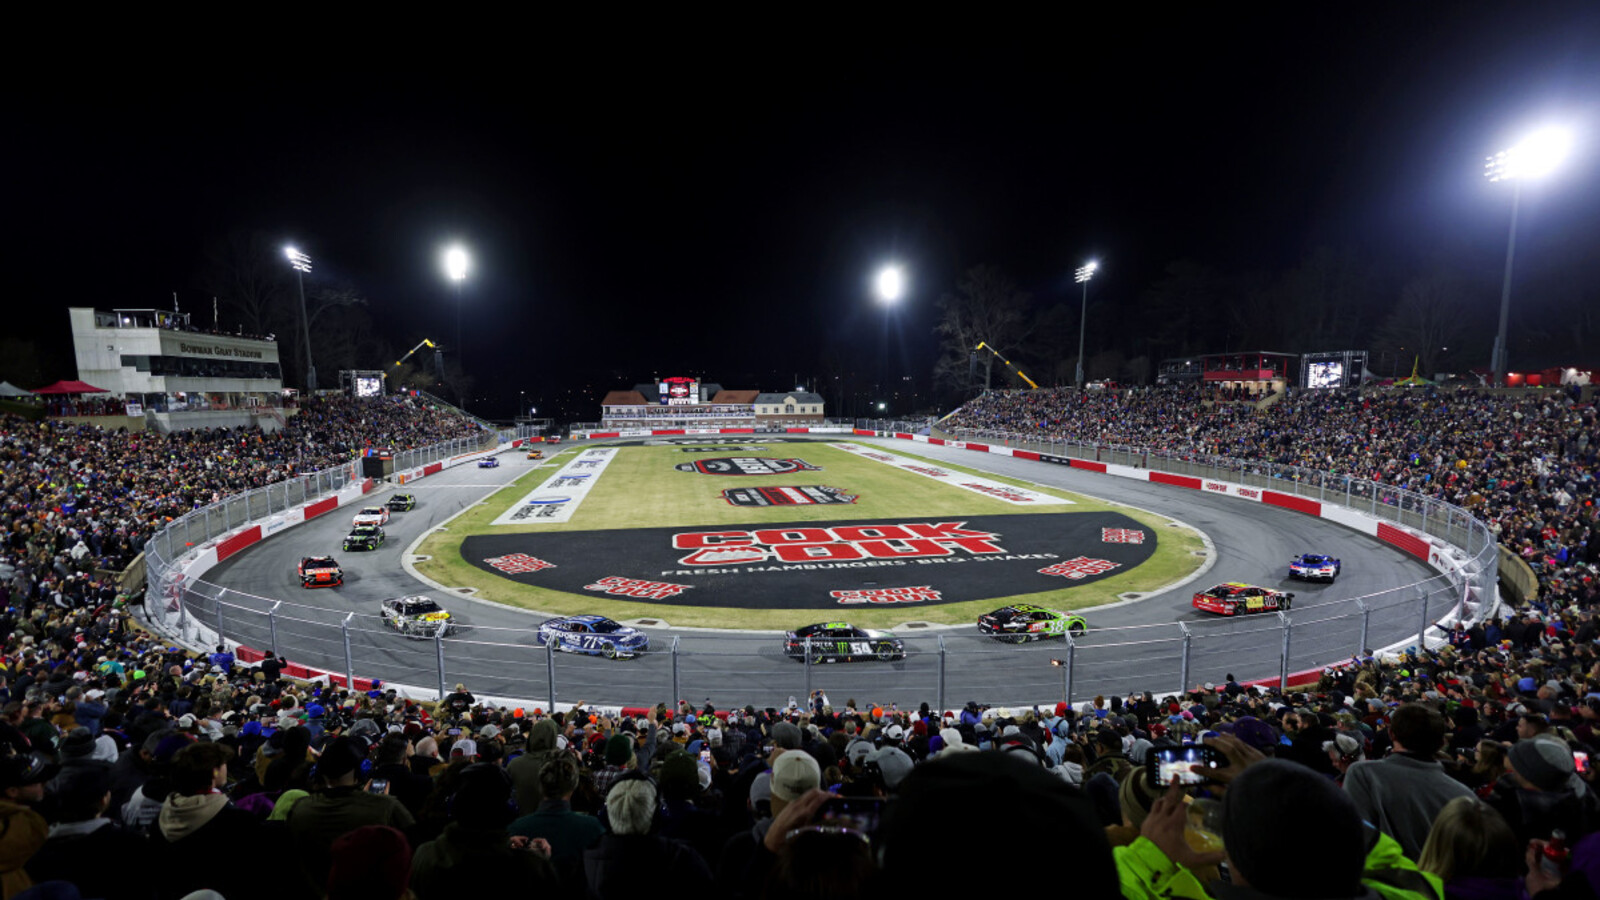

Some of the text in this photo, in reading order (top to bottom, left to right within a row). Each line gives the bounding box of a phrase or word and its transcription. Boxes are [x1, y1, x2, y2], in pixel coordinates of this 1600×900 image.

[672, 521, 1003, 550] COOK
[770, 535, 1008, 563] OUT
[661, 568, 739, 577] FRESH
[747, 559, 906, 573] HAMBURGERS
[972, 553, 1059, 562] SHAKES
[596, 576, 696, 594] COOK
[830, 585, 942, 598] COOK
[605, 585, 683, 600] OUT
[868, 593, 942, 603] OUT
[1048, 620, 1064, 634] 38
[583, 635, 598, 649] 71
[849, 641, 873, 655] 54
